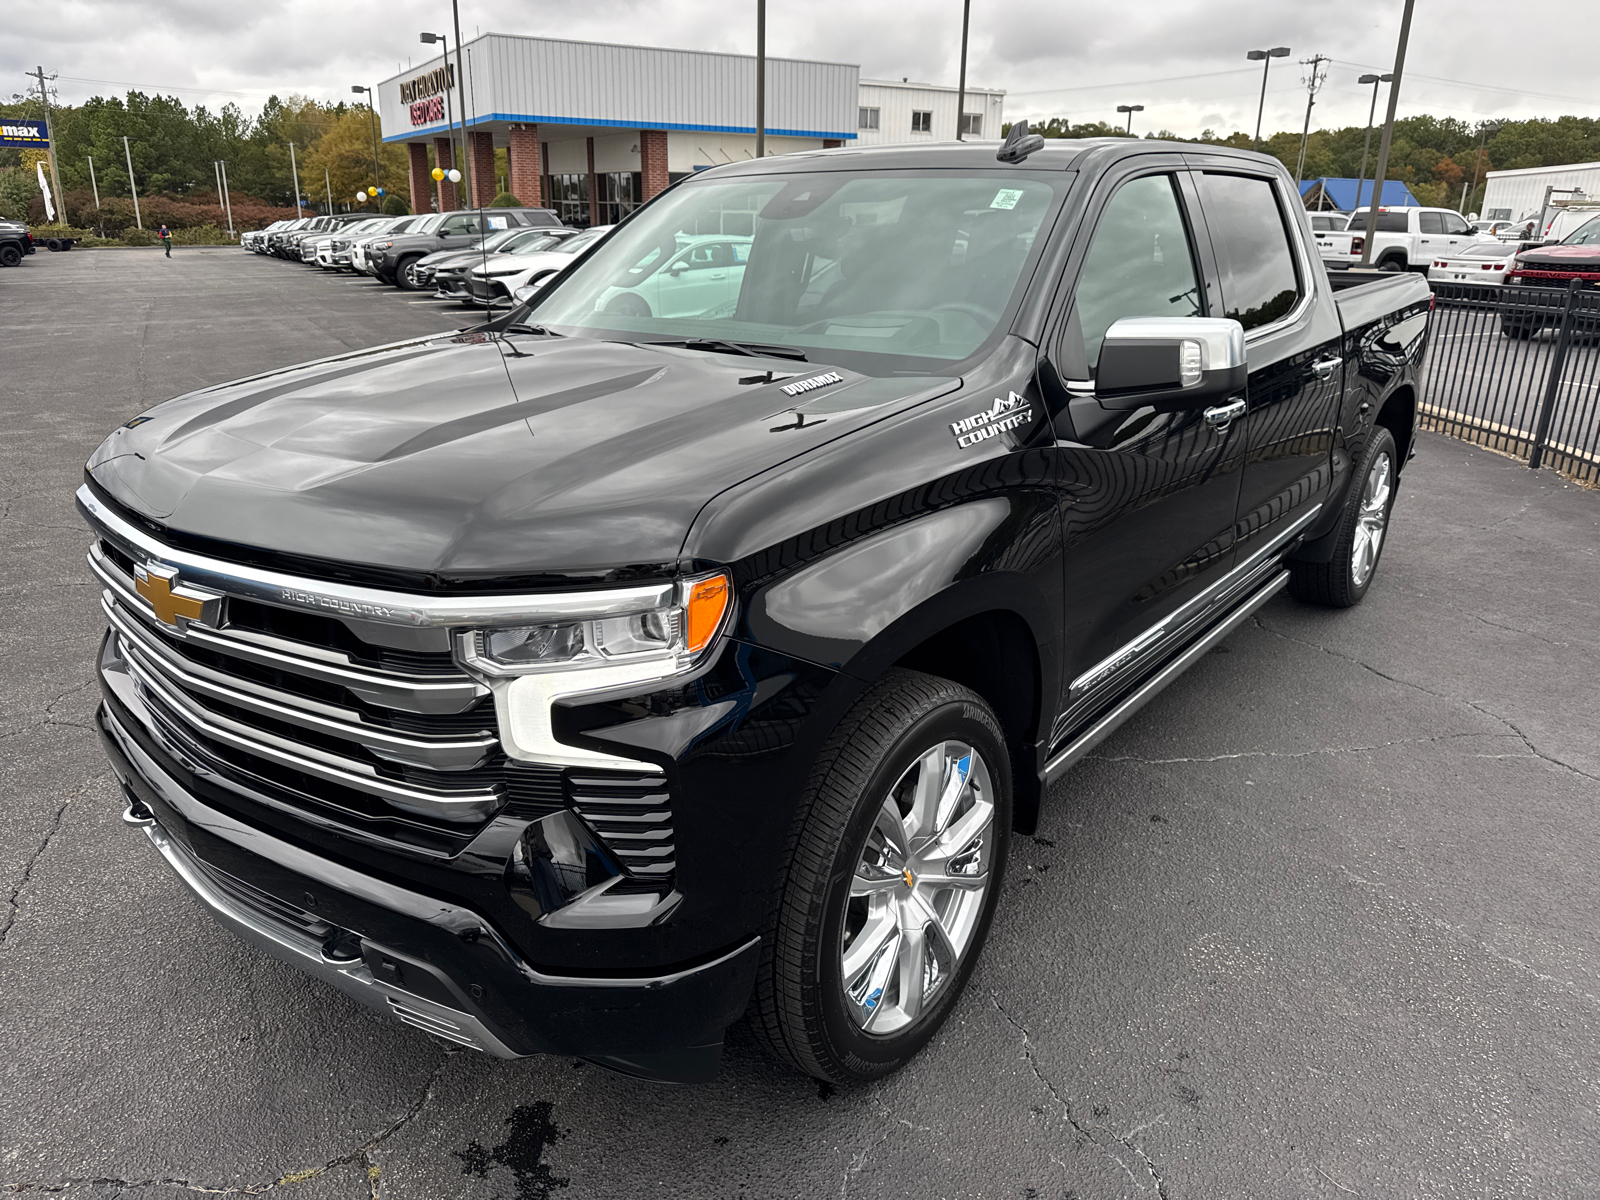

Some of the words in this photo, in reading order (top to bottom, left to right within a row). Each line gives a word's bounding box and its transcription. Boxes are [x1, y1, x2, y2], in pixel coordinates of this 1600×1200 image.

[414, 63, 455, 100] THORNTON
[409, 101, 426, 126] USED
[425, 96, 445, 122] CARS
[779, 371, 844, 397] DURAMAX
[949, 409, 994, 436] HIGH
[957, 409, 1032, 449] COUNTRY
[282, 590, 316, 605] HIGH
[319, 597, 396, 617] COUNTRY
[962, 702, 1004, 747] BRIDGESTONE
